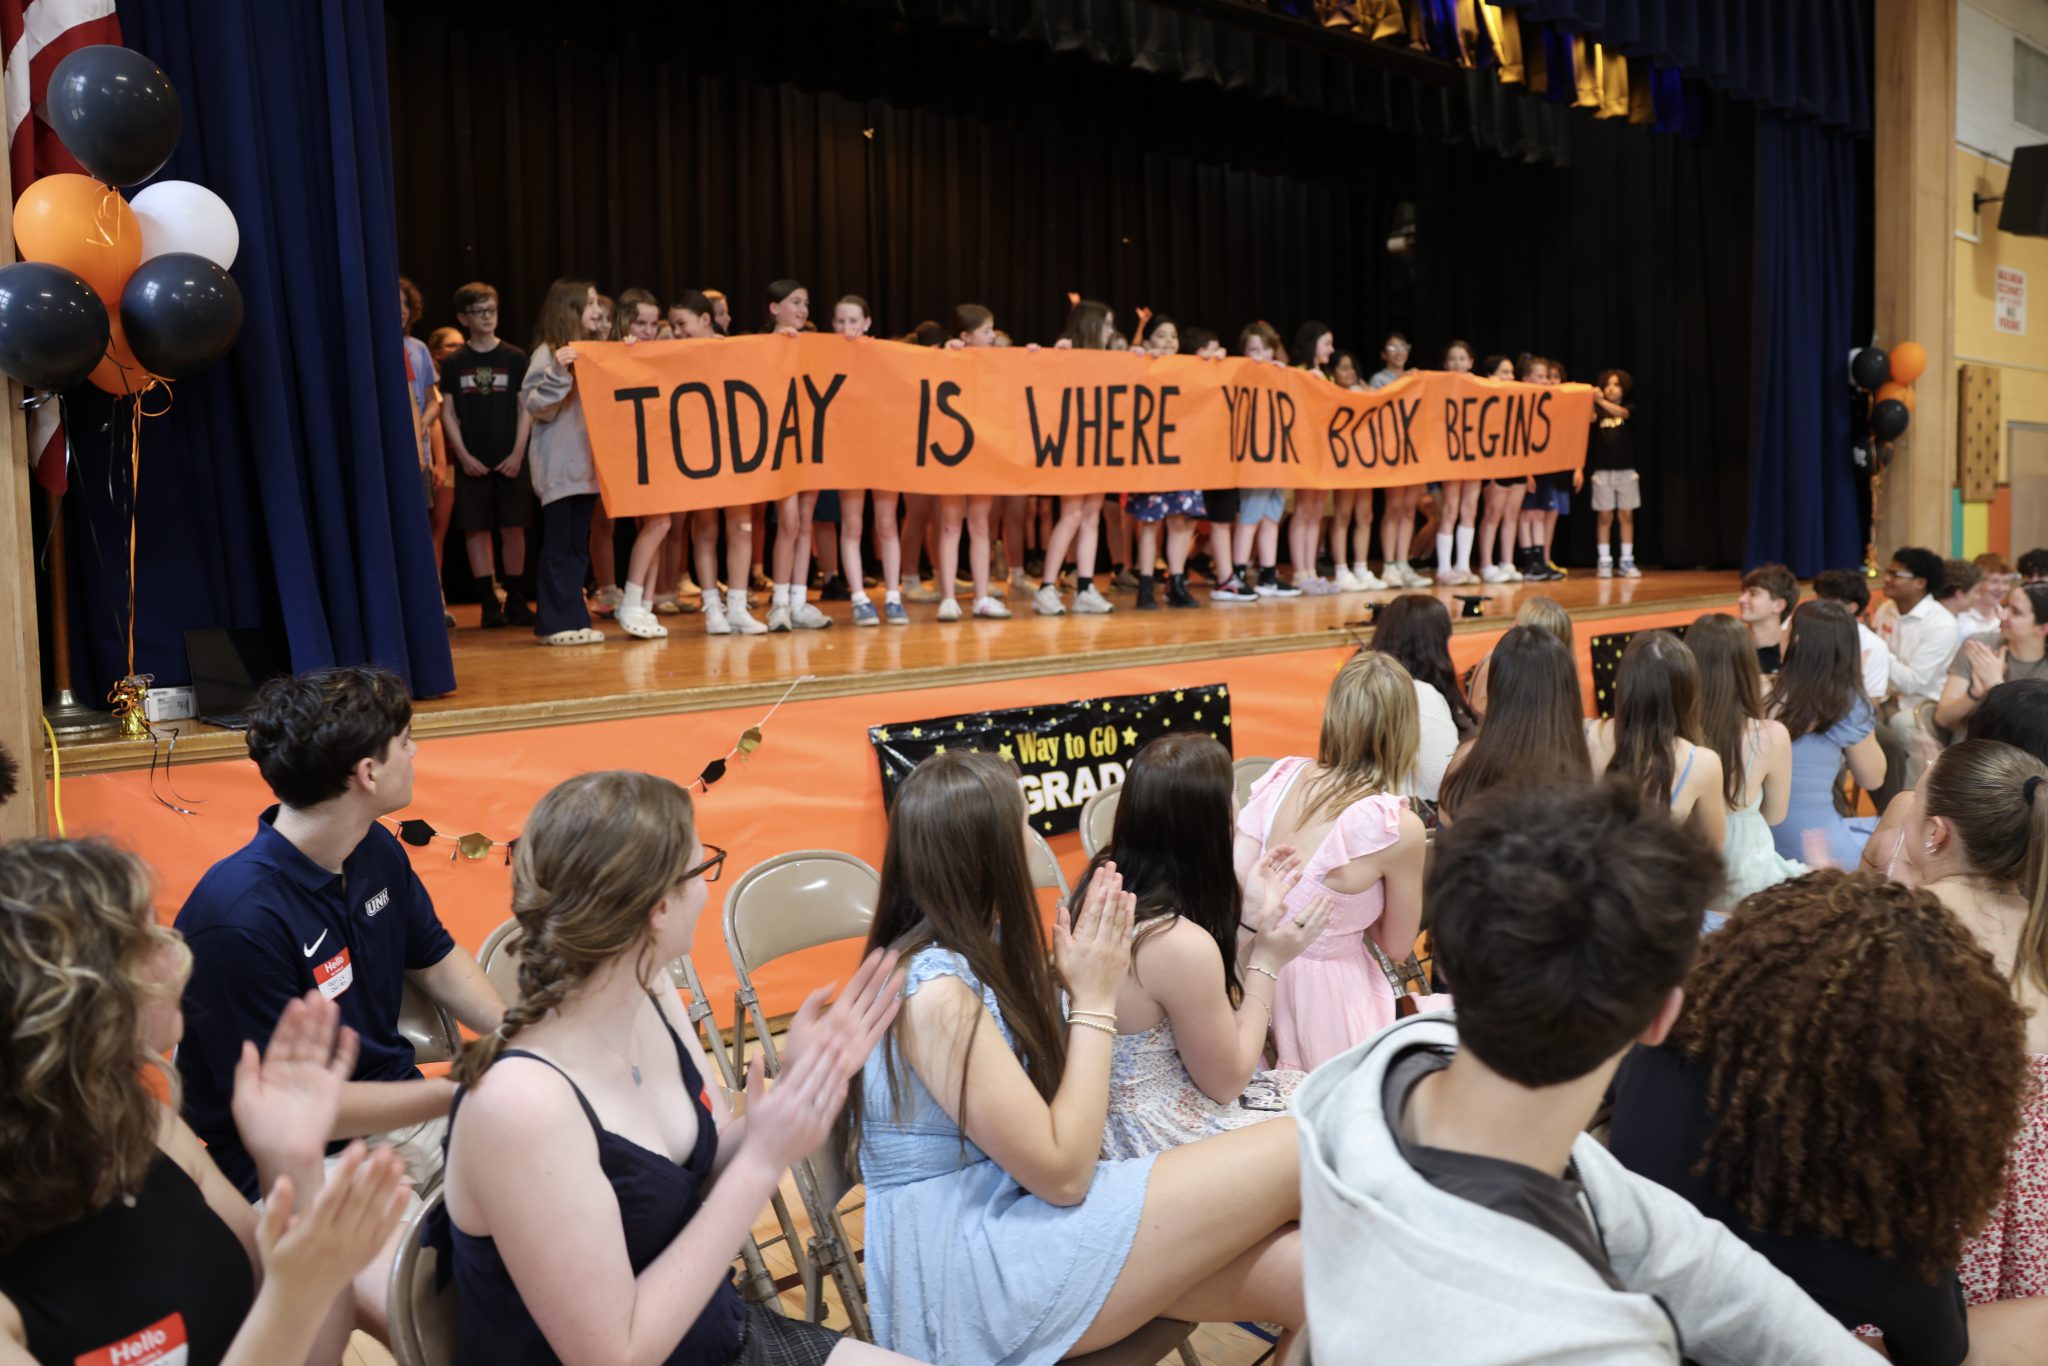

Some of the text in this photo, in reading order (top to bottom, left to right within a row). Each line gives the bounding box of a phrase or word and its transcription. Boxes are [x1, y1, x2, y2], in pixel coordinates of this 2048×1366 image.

[613, 373, 1552, 485] TODAY IS WHERE YOUR BOOK BEGINS
[1015, 731, 1059, 767] Way
[1064, 732, 1085, 760] to
[1018, 759, 1133, 815] GRAD
[365, 888, 389, 916] UNH
[324, 955, 345, 973] Hello
[109, 1329, 167, 1366] Hello
